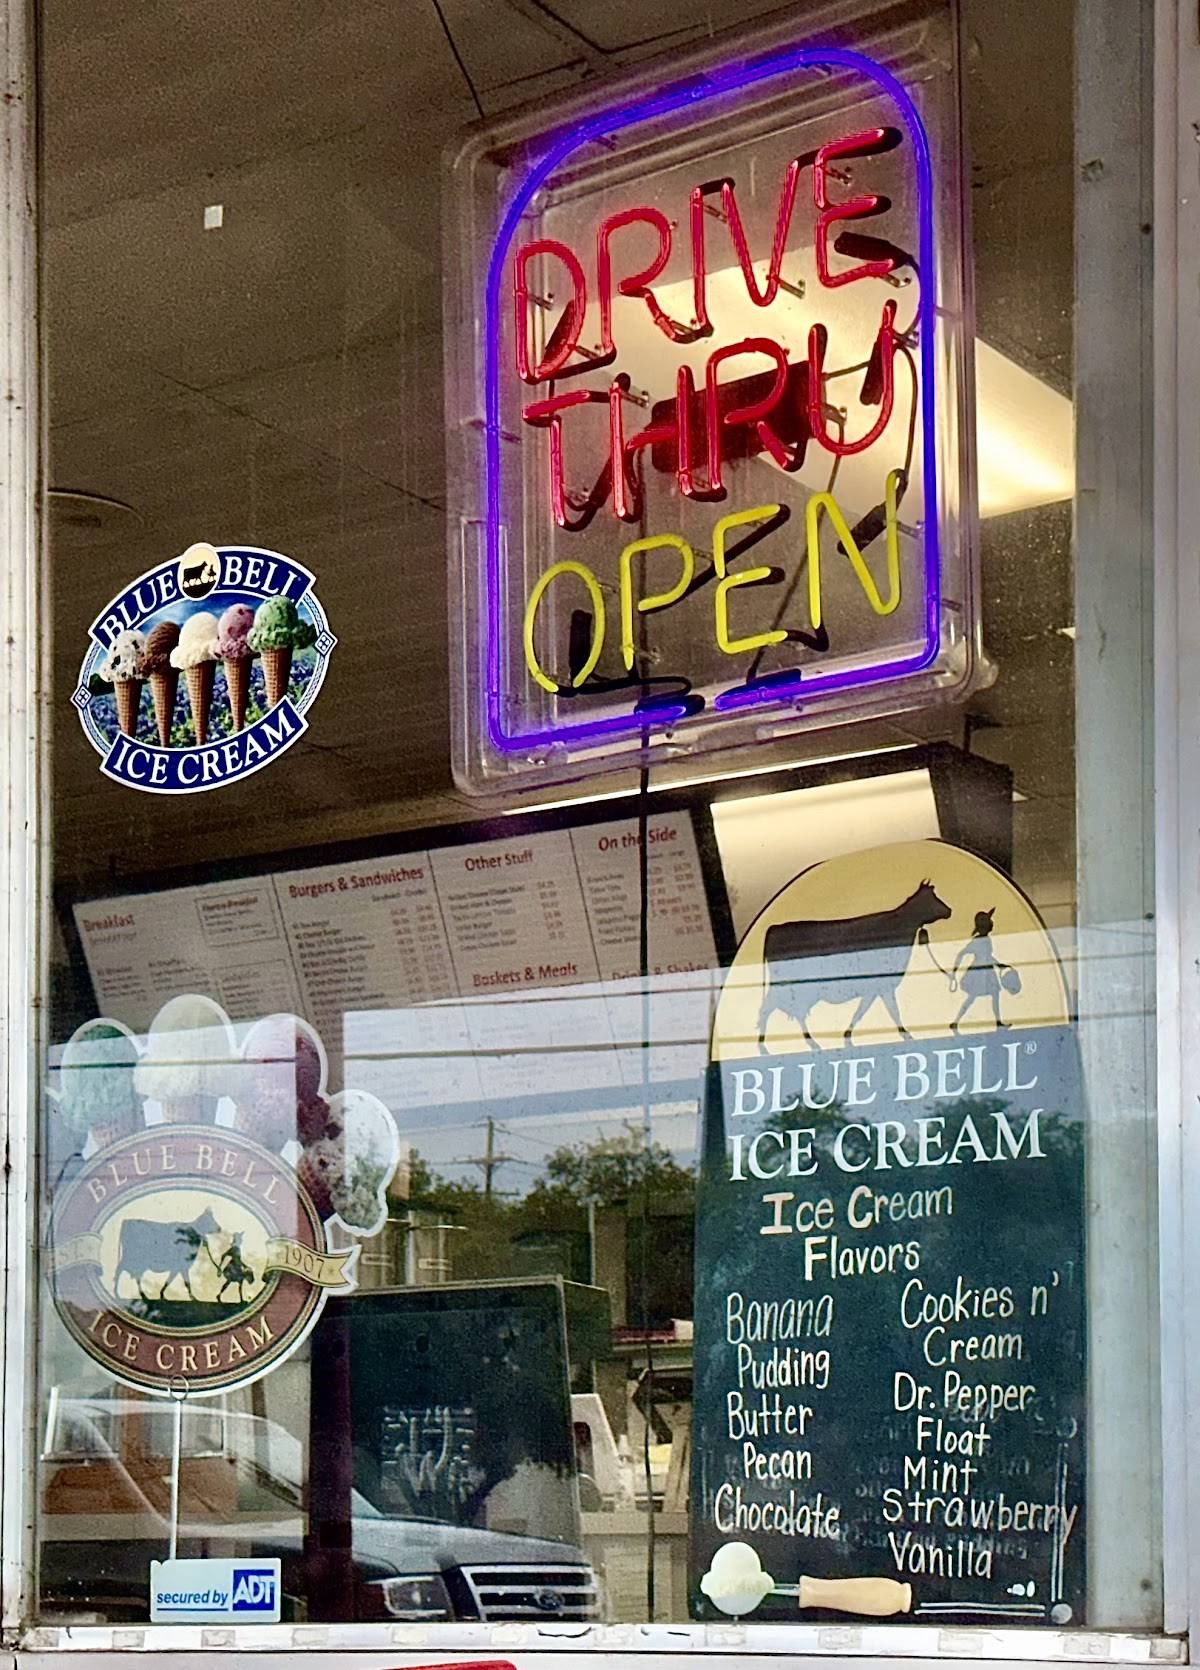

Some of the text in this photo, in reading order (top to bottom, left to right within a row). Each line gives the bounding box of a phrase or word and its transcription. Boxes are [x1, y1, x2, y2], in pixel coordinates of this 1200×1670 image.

[514, 126, 901, 384] DRIVE
[522, 299, 896, 530] THRU
[100, 555, 299, 642] BLUE BELL
[523, 469, 902, 694] OPEN
[113, 716, 296, 785] ICE CREAM
[465, 850, 533, 871] Other Stuff
[598, 837, 618, 851] On
[649, 827, 677, 842] Side
[289, 867, 424, 898] Burgers & Sandwiches
[83, 914, 135, 932] Breakfast
[473, 962, 578, 987] Baskets & Meals
[730, 1058, 877, 1117] BLUE
[728, 1108, 1047, 1182] ICE CREAM
[87, 1144, 280, 1204] BLUE BELL
[760, 1185, 953, 1235] Ice Cream
[282, 1243, 326, 1280] 1907
[804, 1236, 920, 1281] Flavors
[726, 1292, 833, 1345] Banana
[900, 1276, 1014, 1329] Cookies
[88, 1311, 277, 1372] ICE CREAM
[737, 1343, 830, 1389] Pudding
[924, 1326, 1024, 1367] Cream
[727, 1391, 814, 1440] Butter
[893, 1370, 1036, 1420] Dr. Pepper
[743, 1441, 812, 1480] Pecan
[917, 1416, 991, 1456] Float
[904, 1456, 977, 1495] Mint
[714, 1482, 840, 1537] Chocolate
[883, 1488, 1078, 1546] Strawberry
[888, 1531, 993, 1579] Vanilla
[156, 1574, 276, 1607] secured by ADT
